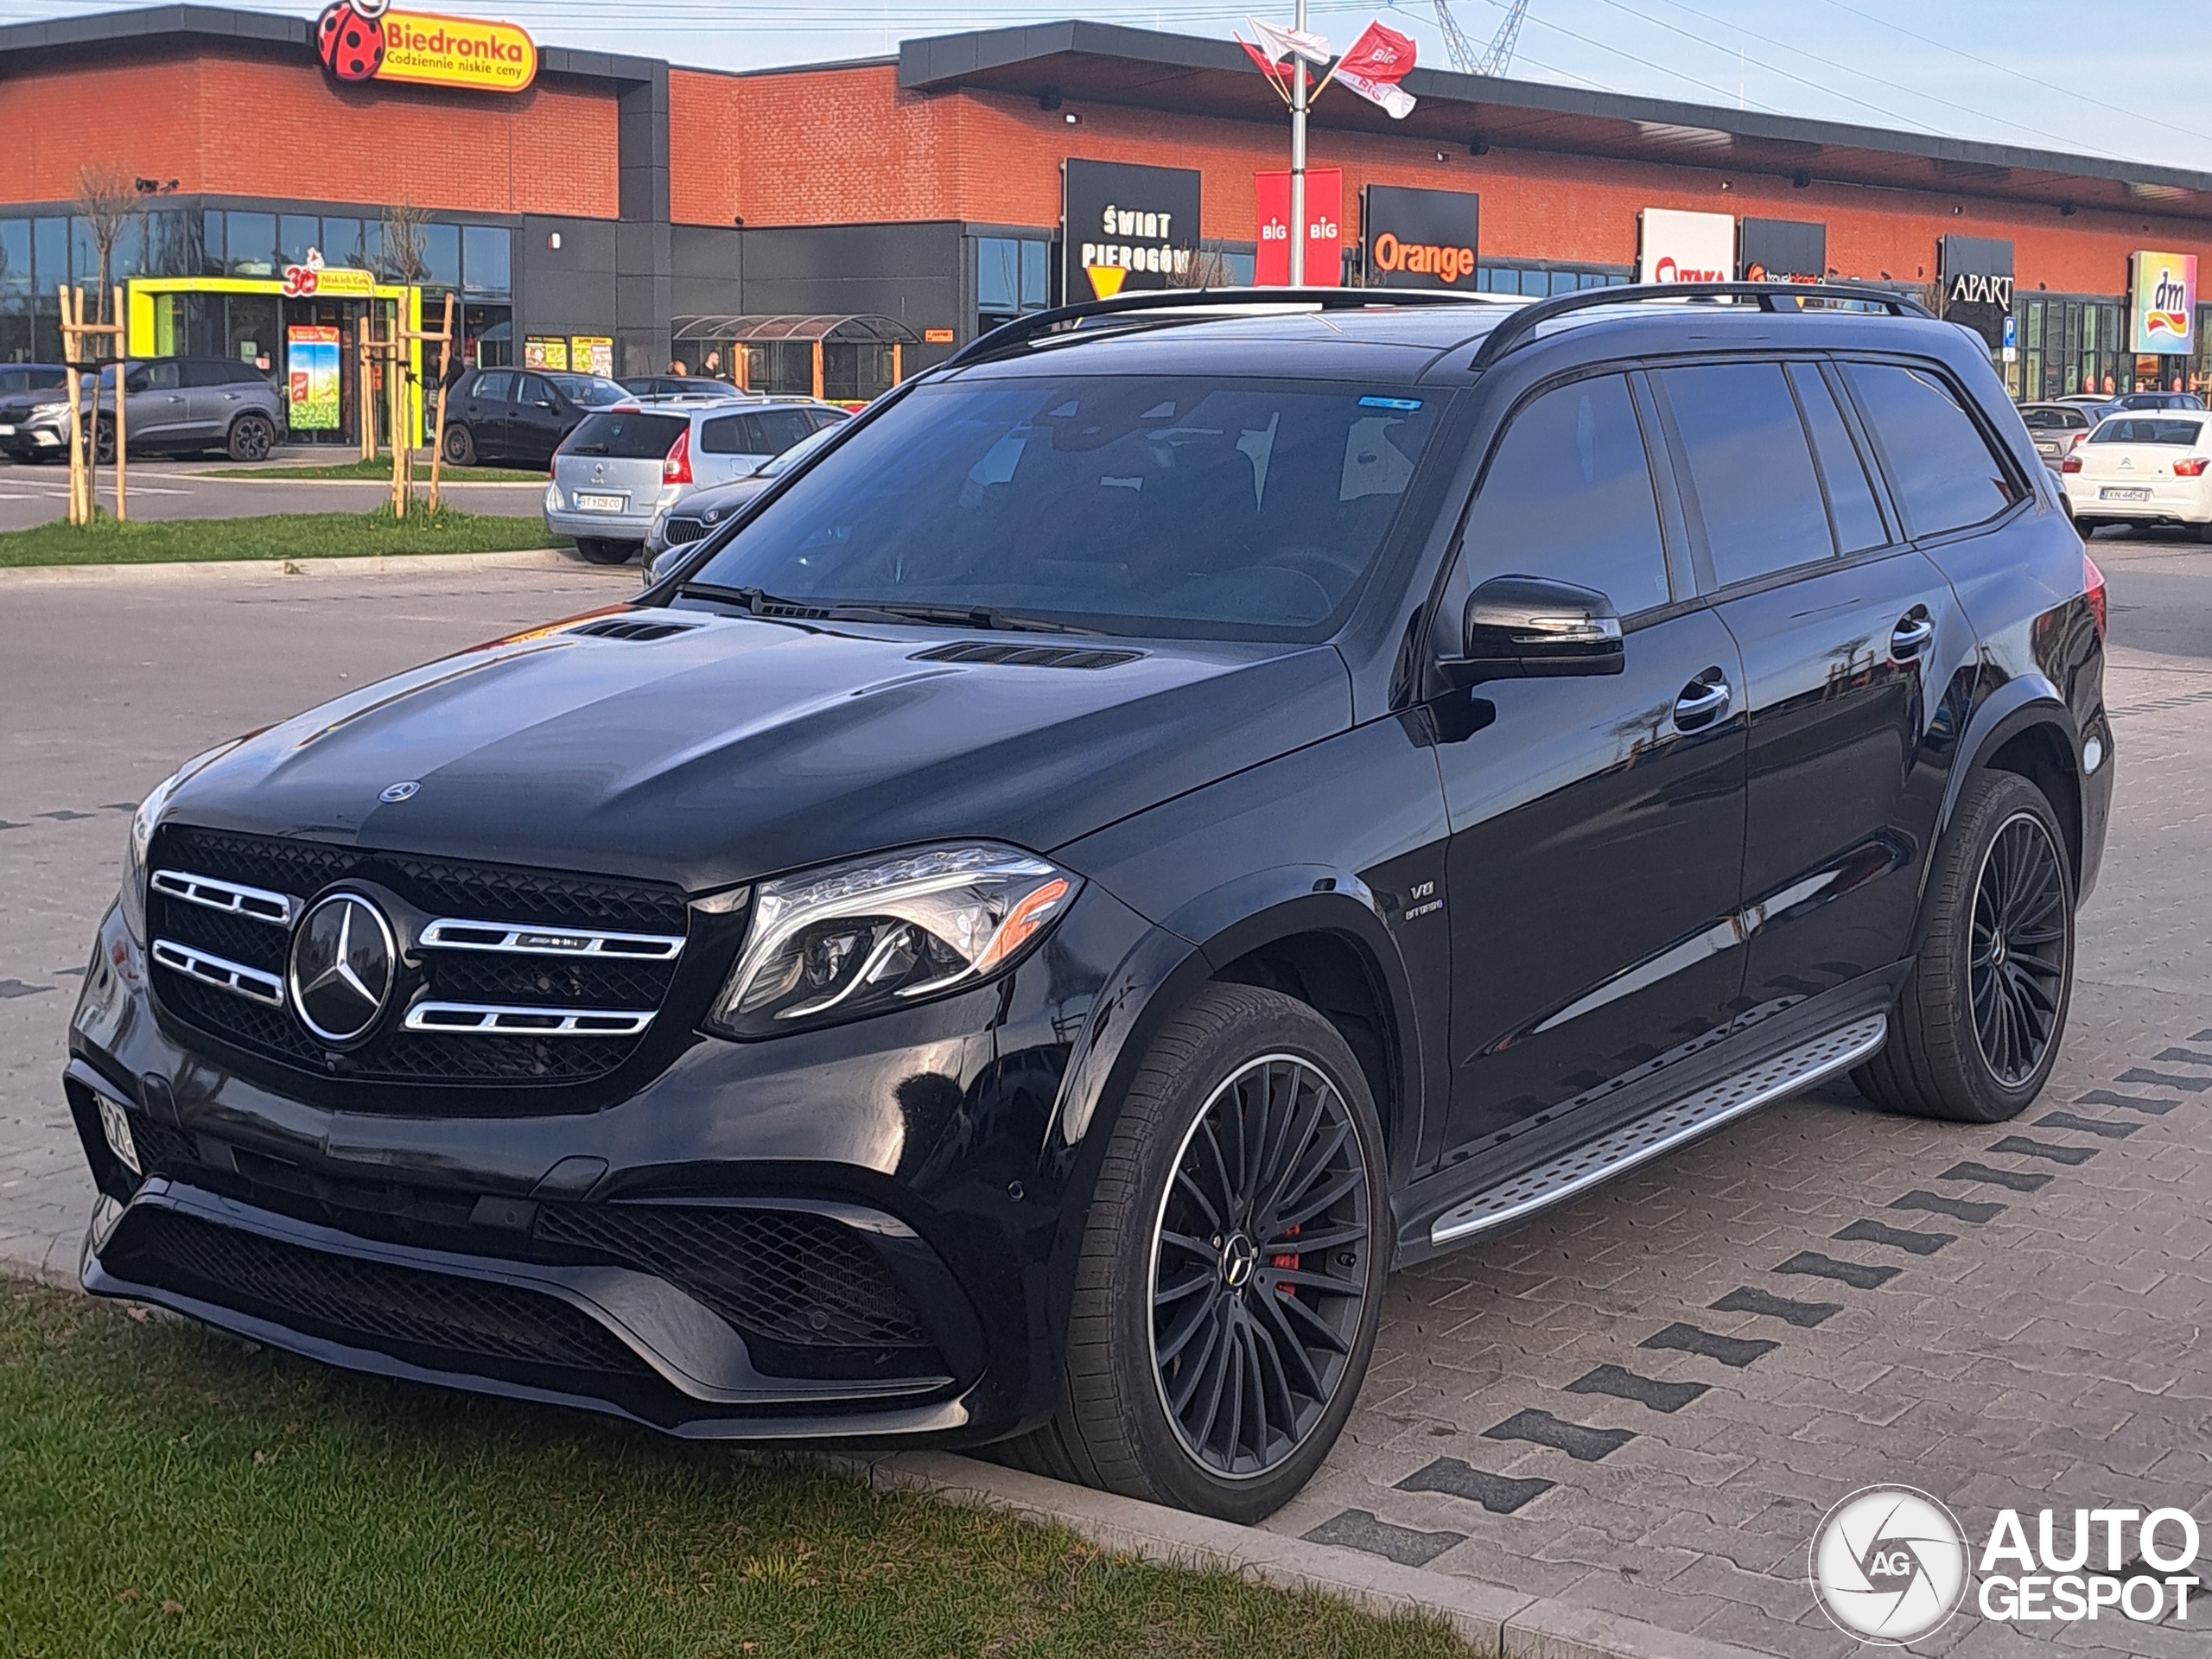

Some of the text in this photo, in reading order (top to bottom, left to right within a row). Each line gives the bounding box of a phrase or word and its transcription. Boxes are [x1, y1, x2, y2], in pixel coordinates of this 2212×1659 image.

[387, 22, 523, 62] Biedronka
[387, 51, 522, 79] Codziennie niskie ceny
[1104, 205, 1171, 238] ŚWIAT
[1082, 243, 1190, 274] PIEROGÓW
[1375, 232, 1474, 283] Orange
[283, 268, 318, 294] 30
[1951, 273, 2014, 312] APART
[2156, 271, 2183, 311] dm
[2005, 320, 2014, 339] P
[1410, 880, 1434, 899] V8
